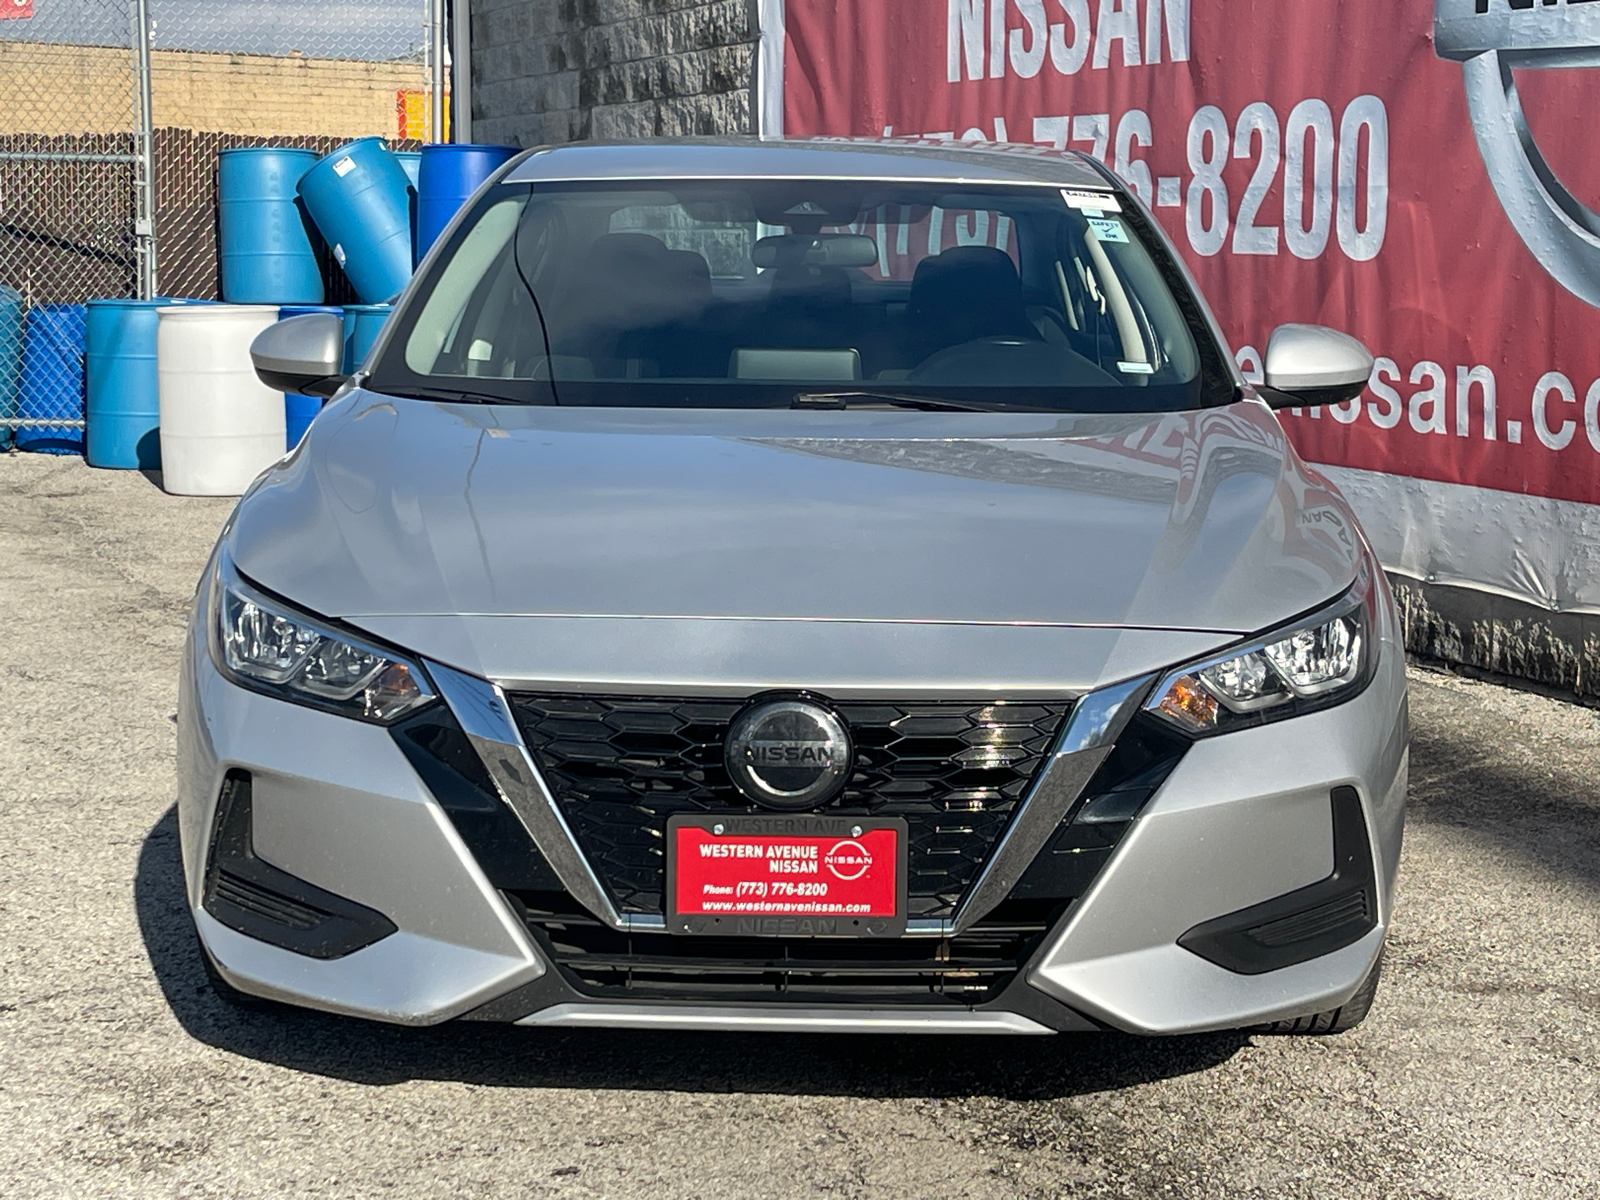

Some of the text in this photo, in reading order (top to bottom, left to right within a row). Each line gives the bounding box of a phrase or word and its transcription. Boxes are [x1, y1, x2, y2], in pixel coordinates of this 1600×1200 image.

[947, 0, 1190, 83] NISSAN
[1235, 345, 1600, 451] esan.c
[744, 746, 834, 762] NISSAN
[725, 818, 847, 835] WESTERN AVE
[699, 844, 818, 859] WESTERN AVENUE
[769, 860, 818, 873] NISSAN
[825, 855, 873, 865] NISSAN
[703, 881, 828, 898] Phone: (773) 776-8200
[702, 900, 871, 913] www.westernavenissan.com
[736, 918, 837, 935] NISSAN
